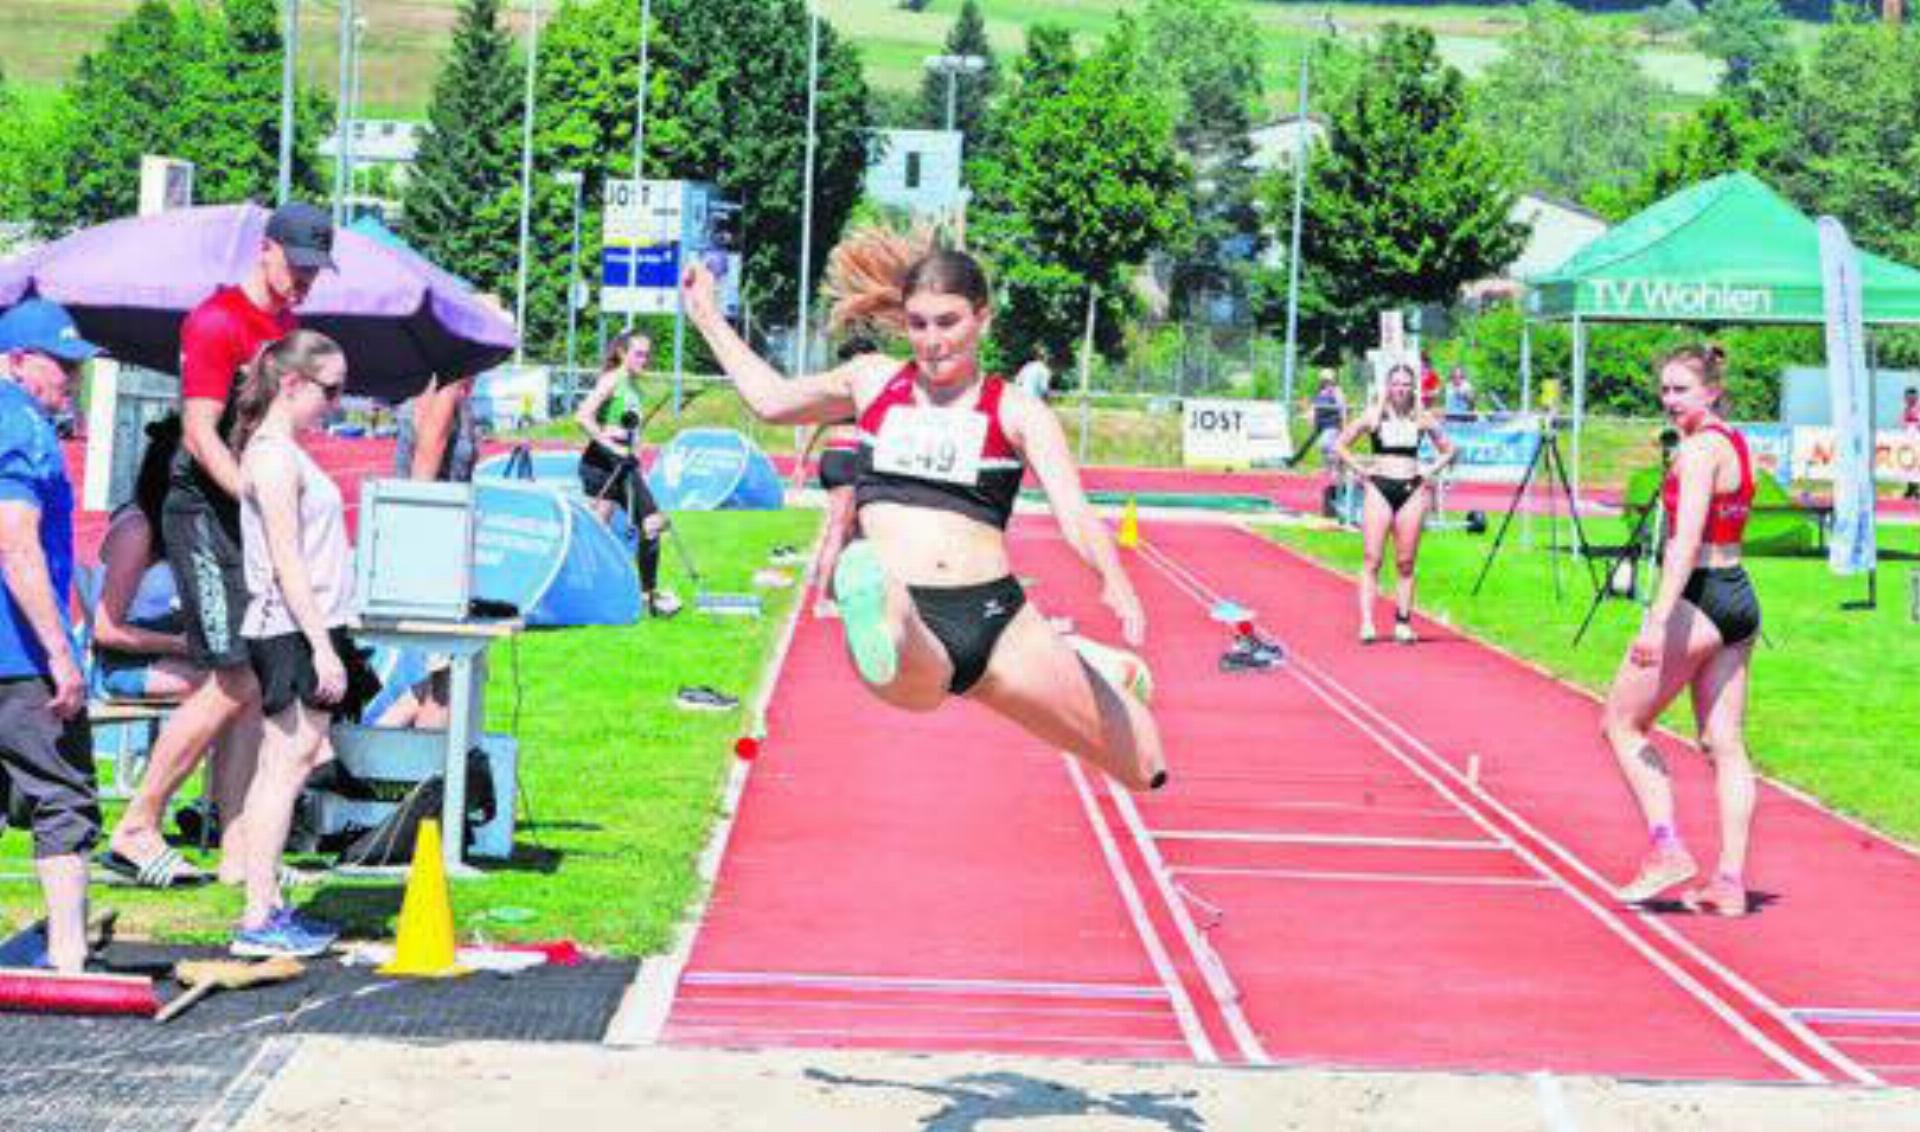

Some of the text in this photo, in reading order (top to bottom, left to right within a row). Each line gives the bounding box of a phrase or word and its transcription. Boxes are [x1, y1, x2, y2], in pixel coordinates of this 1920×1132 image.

[1589, 279, 1772, 314] TV Wohlen
[1190, 410, 1243, 431] JOST
